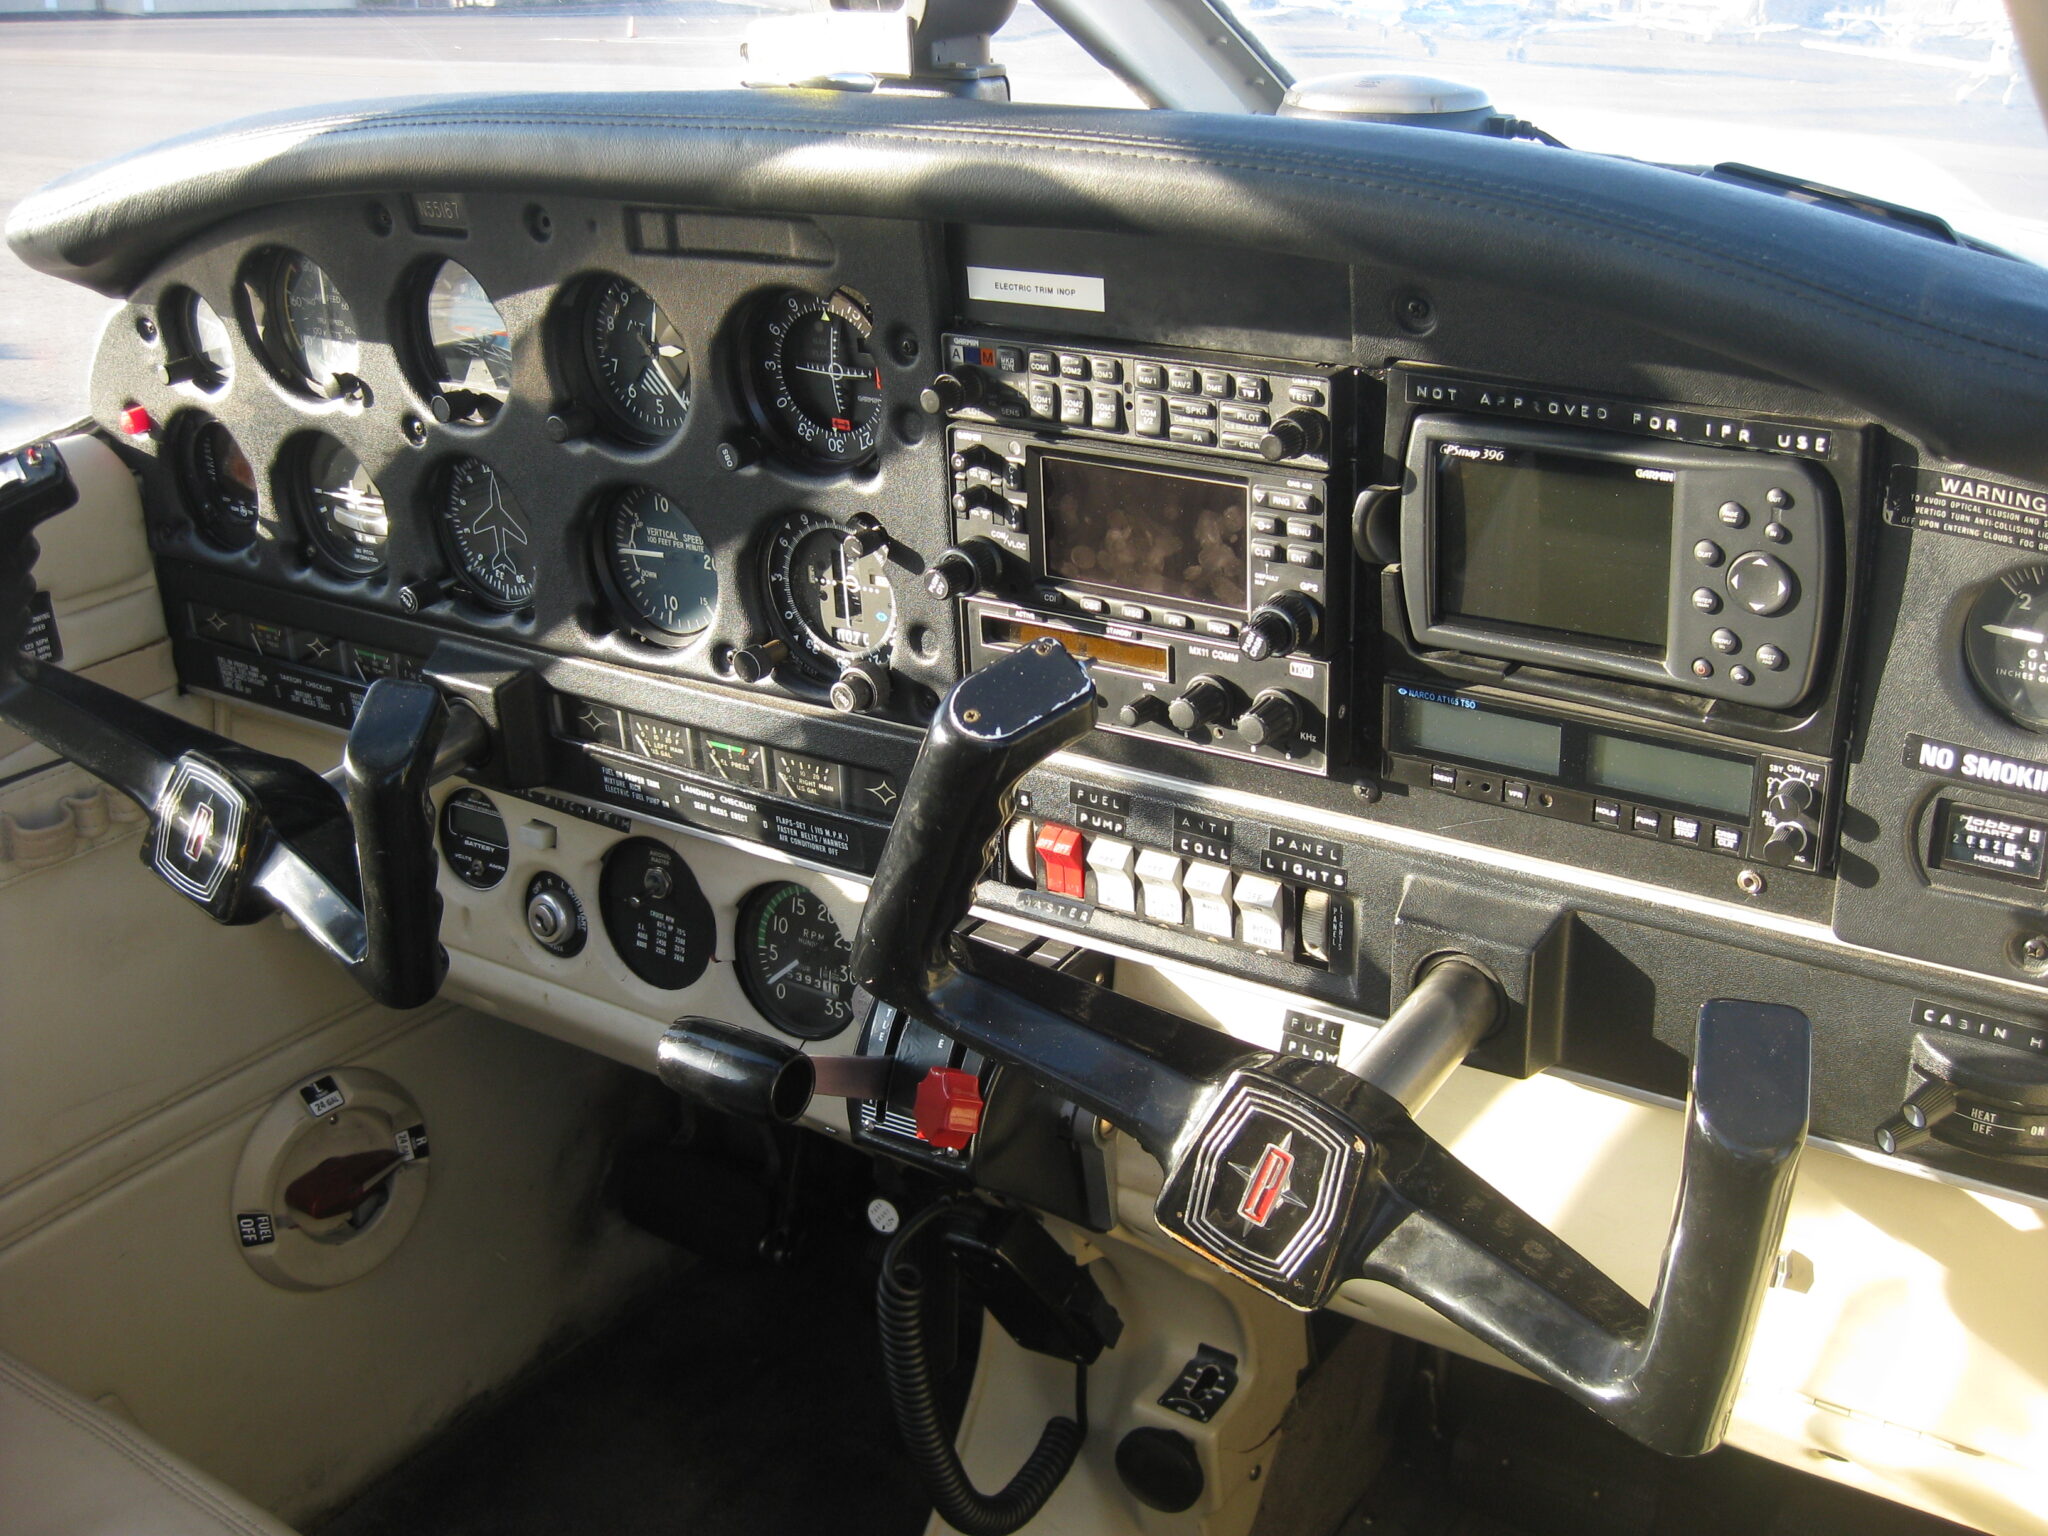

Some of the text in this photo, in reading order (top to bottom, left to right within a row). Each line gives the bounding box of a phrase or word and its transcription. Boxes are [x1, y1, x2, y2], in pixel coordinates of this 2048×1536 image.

[995, 282, 1075, 296] ELECTRIC TRIM INOP
[621, 292, 628, 306] 9
[788, 298, 798, 312] 9
[606, 317, 614, 331] 8
[769, 324, 780, 335] 6
[952, 349, 993, 363] A M
[1000, 357, 1014, 365] MKR
[612, 358, 618, 372] 7
[765, 361, 776, 370] 3
[1031, 364, 1049, 373] COM1
[1062, 367, 1081, 375] COM2
[1094, 371, 1113, 379] COM3
[628, 384, 636, 398] 6
[1206, 384, 1223, 393] DME
[777, 397, 787, 408] 0
[1063, 400, 1083, 408] COM2
[1290, 393, 1313, 403] TEST
[656, 400, 664, 413] 5
[1001, 407, 1020, 417] SENS
[1036, 403, 1048, 411] MIC
[1067, 407, 1080, 415] MIC
[1095, 403, 1115, 412] COM3
[1140, 409, 1157, 417] COM
[1185, 407, 1208, 415] SPKR
[1236, 412, 1260, 422] PILOT
[1416, 386, 1457, 401] NOT
[1633, 413, 1677, 433] FOR
[1777, 434, 1826, 452] USE
[798, 423, 814, 441] 33
[1193, 434, 1203, 442] PA
[828, 438, 845, 453] 30
[859, 432, 873, 450] 27
[1239, 440, 1260, 449] CREW
[721, 449, 733, 467] OBS
[1439, 444, 1505, 462] GPSmap 396
[1635, 468, 1674, 482] GARMIN
[1272, 496, 1290, 506] RNG
[1941, 477, 2047, 512] WARNING
[654, 496, 669, 513] 10
[1911, 494, 1920, 503] TO
[1924, 496, 1946, 507] AVOID
[1950, 501, 1981, 513] OPTICAL
[1986, 508, 2020, 521] ILLUSION
[2024, 516, 2040, 525] AND
[800, 514, 808, 525] 9
[1915, 506, 1946, 518] VERTIGO
[1951, 513, 1970, 522] TURN
[1974, 517, 2033, 535] ANTI-COLLISION
[646, 527, 704, 545] VERTICAL SPEED
[1289, 527, 1311, 537] MENU
[1901, 516, 1916, 526] OFF
[1919, 519, 1940, 529] UPON
[1943, 523, 1980, 537] ENTERING
[2020, 539, 2035, 548] FOG
[647, 536, 704, 552] 100 FEET PER MINUTE
[780, 538, 788, 547] 6
[1254, 548, 1271, 558] CLR
[1291, 554, 1307, 563] ENT
[1300, 582, 1318, 592] GPS
[664, 594, 678, 611] 10
[1044, 594, 1056, 602] CDI
[2019, 593, 2031, 610] 2
[1207, 624, 1230, 635] PROC
[1241, 630, 1255, 652] PUSH
[1211, 650, 1238, 662] COMM
[1996, 668, 2033, 681] INCHES
[1408, 690, 1476, 709] NARCO TSO
[1300, 732, 1316, 742] KHz
[1919, 743, 1954, 770] NO
[602, 767, 615, 777] FUEL
[1769, 764, 1784, 774] SBY
[1787, 764, 1799, 774] ON
[603, 776, 626, 789] MIXTURE
[1433, 773, 1454, 783] IDENT
[1806, 772, 1820, 782] ALT
[605, 785, 644, 801] ELECTRIC FUEL
[819, 783, 834, 792] MAIN
[1508, 790, 1523, 798] VFR
[680, 784, 757, 812] LANDING CHECKLIST
[1077, 789, 1120, 809] FUEL
[731, 811, 748, 823] ERECT
[1596, 807, 1617, 817] HOLD
[776, 816, 806, 830] FLAPS-SET
[1079, 813, 1123, 832] PUMP
[1636, 816, 1657, 827] FUNC
[1674, 818, 1698, 829] START
[1959, 814, 2024, 834] Hobbs
[777, 825, 798, 837] FASTEN
[1675, 829, 1696, 839] STOP
[1965, 824, 2016, 840] QUARTZ
[465, 840, 495, 853] BATTERY
[779, 834, 838, 856] AIR CONDITIONER OFF
[1181, 838, 1228, 860] COLL
[1276, 836, 1338, 861] PANEL
[1973, 853, 2016, 868] HOURS
[1266, 857, 1344, 886] LIGHTS
[792, 897, 806, 916] 15
[1017, 895, 1089, 922] MASTER
[650, 910, 664, 919] CRUISE
[774, 916, 788, 934] 10
[803, 928, 824, 940] RPM
[769, 944, 778, 960] 5
[776, 983, 786, 999] 0
[825, 999, 844, 1018] 35
[1291, 1017, 1337, 1040] FUEL
[1923, 1009, 2008, 1040] CABIN
[1970, 1108, 1997, 1123] HEAT
[1972, 1123, 1994, 1137] DEF.
[2030, 1125, 2045, 1136] ON
[415, 1135, 427, 1146] R
[1244, 1151, 1284, 1217] P
[240, 1219, 257, 1240] OFF
[257, 1216, 272, 1240] FUEL
